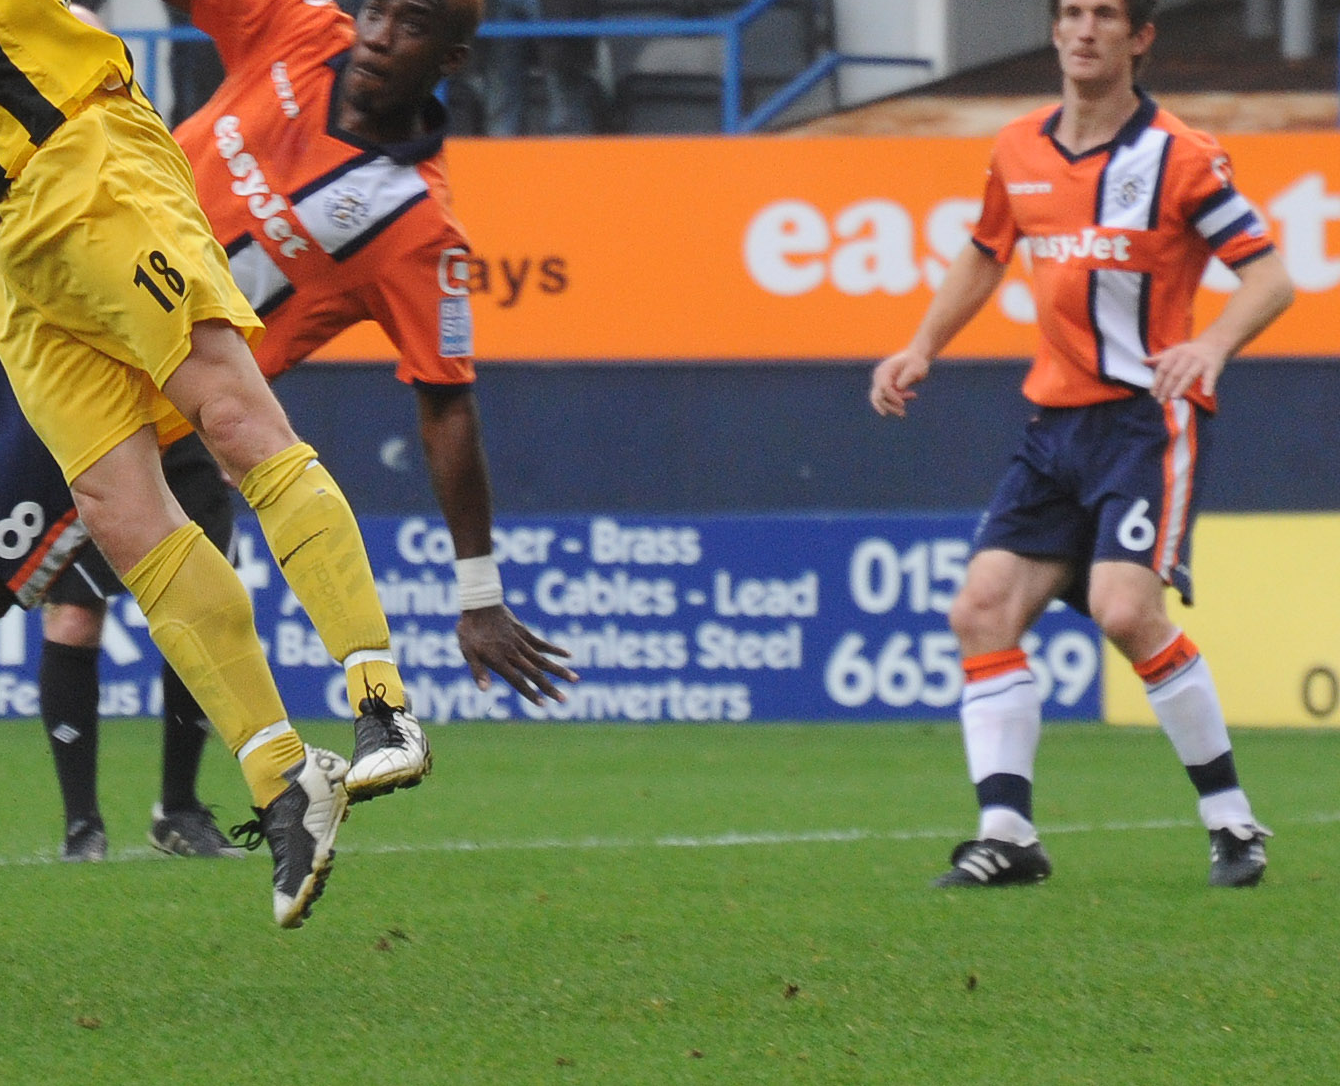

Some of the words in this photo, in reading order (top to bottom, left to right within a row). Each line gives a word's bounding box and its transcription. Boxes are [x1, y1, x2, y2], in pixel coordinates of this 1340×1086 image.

[213, 114, 309, 260] easyJet
[1028, 228, 1132, 264] asyJet
[133, 249, 186, 314] 18
[396, 517, 556, 566] Coer
[589, 516, 703, 566] Brass
[1117, 498, 1156, 552] 6
[534, 568, 678, 617] Cables
[713, 569, 820, 617] Lead
[275, 621, 464, 669] Baries
[695, 621, 804, 669] Steel
